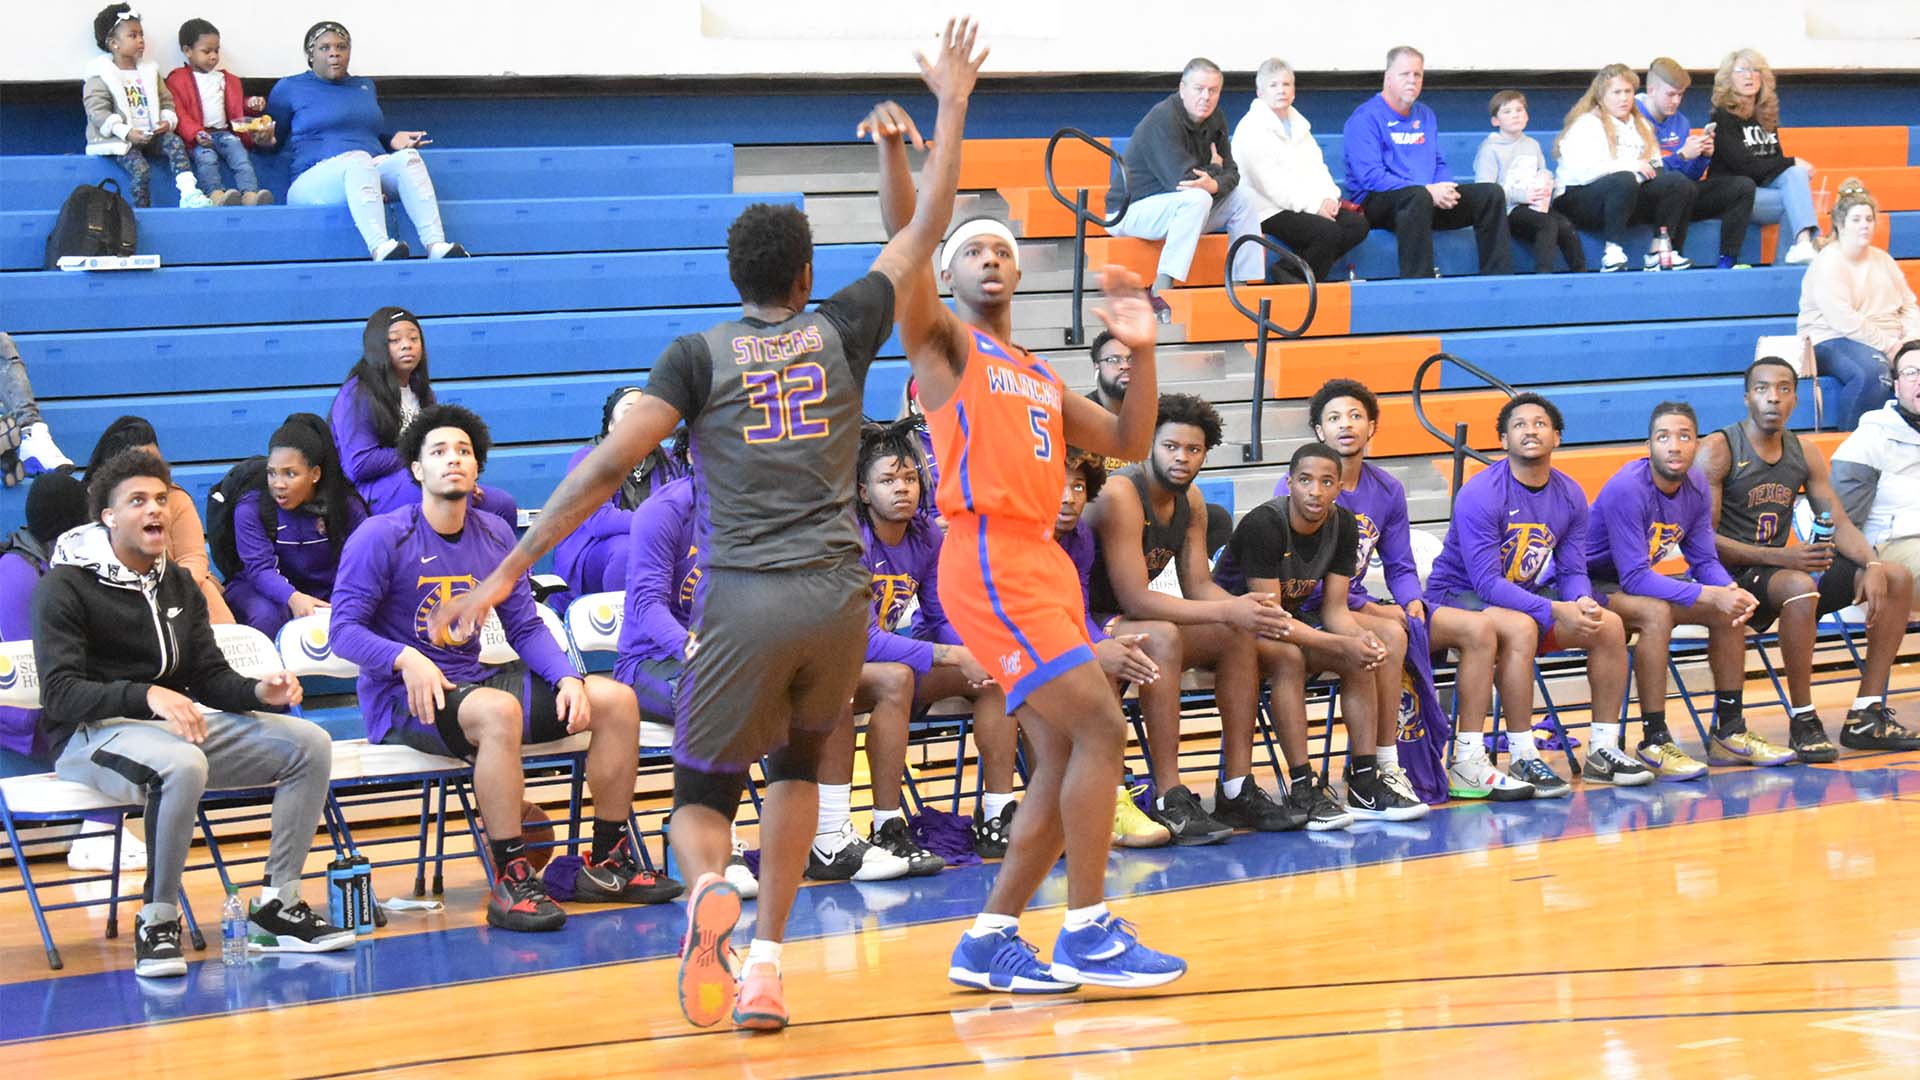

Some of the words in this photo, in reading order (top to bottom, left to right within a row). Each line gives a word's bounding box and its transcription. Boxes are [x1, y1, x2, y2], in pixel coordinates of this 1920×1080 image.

[731, 325, 824, 365] STEERS
[742, 361, 830, 444] 32
[1026, 404, 1052, 463] 5
[1747, 482, 1793, 509] TEXAS
